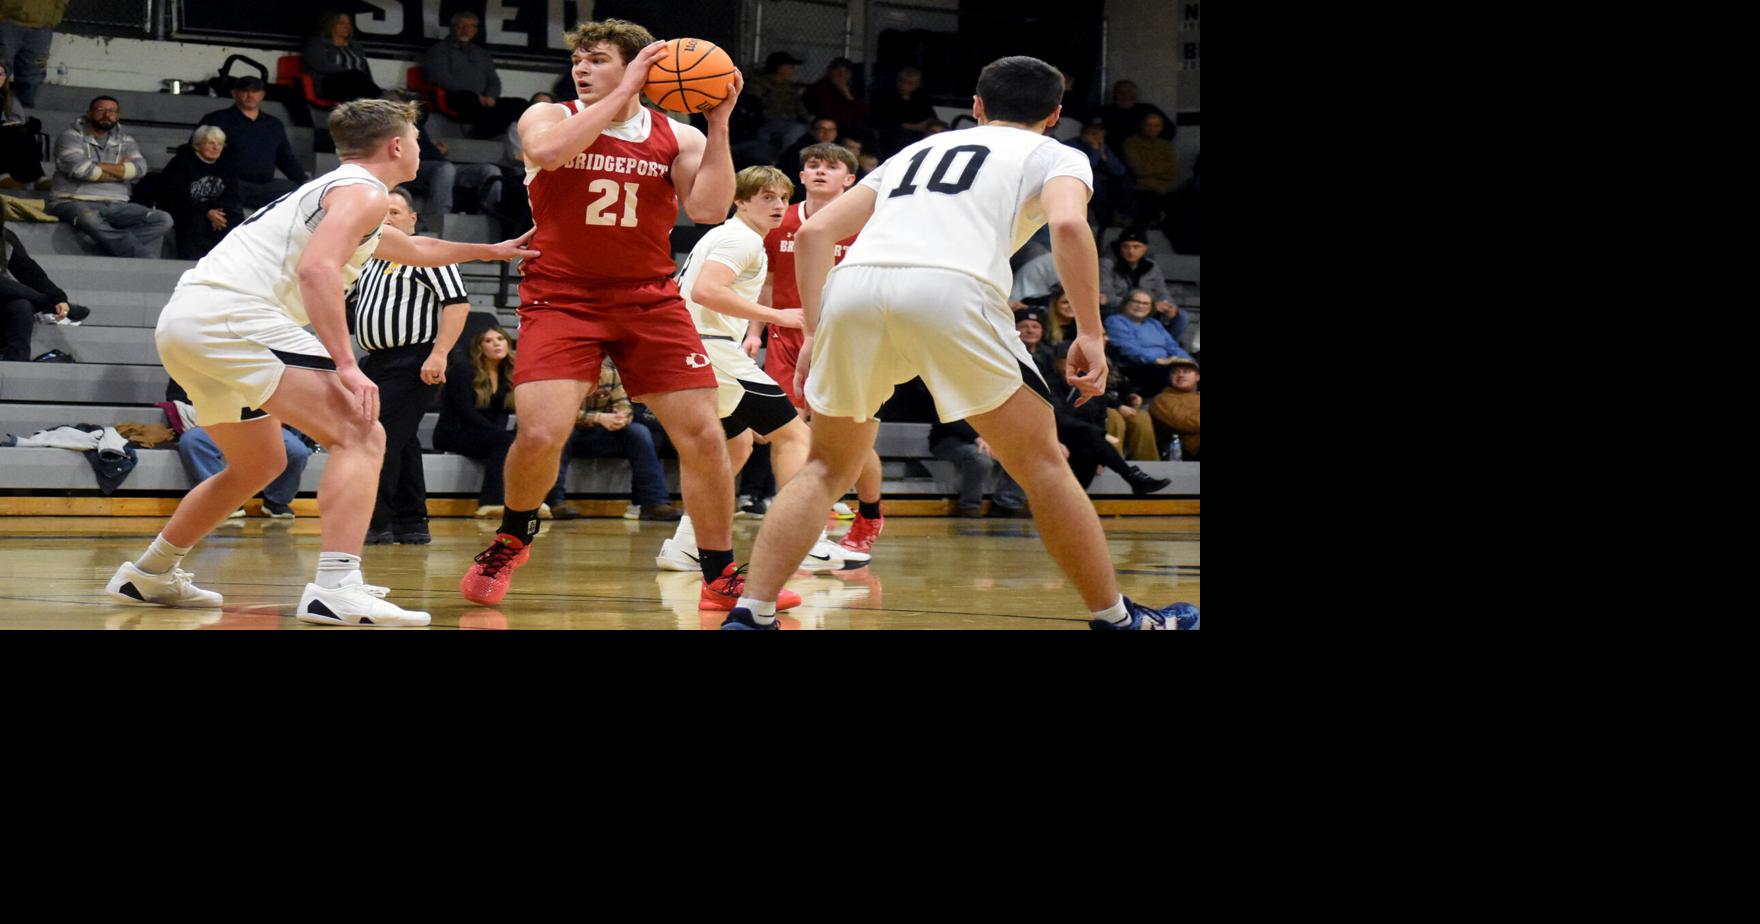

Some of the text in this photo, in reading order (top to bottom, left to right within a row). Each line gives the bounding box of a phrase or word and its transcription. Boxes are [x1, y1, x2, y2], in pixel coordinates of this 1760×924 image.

[564, 153, 668, 178] BRIDGEPORT
[888, 144, 991, 198] 10
[585, 179, 639, 228] 21
